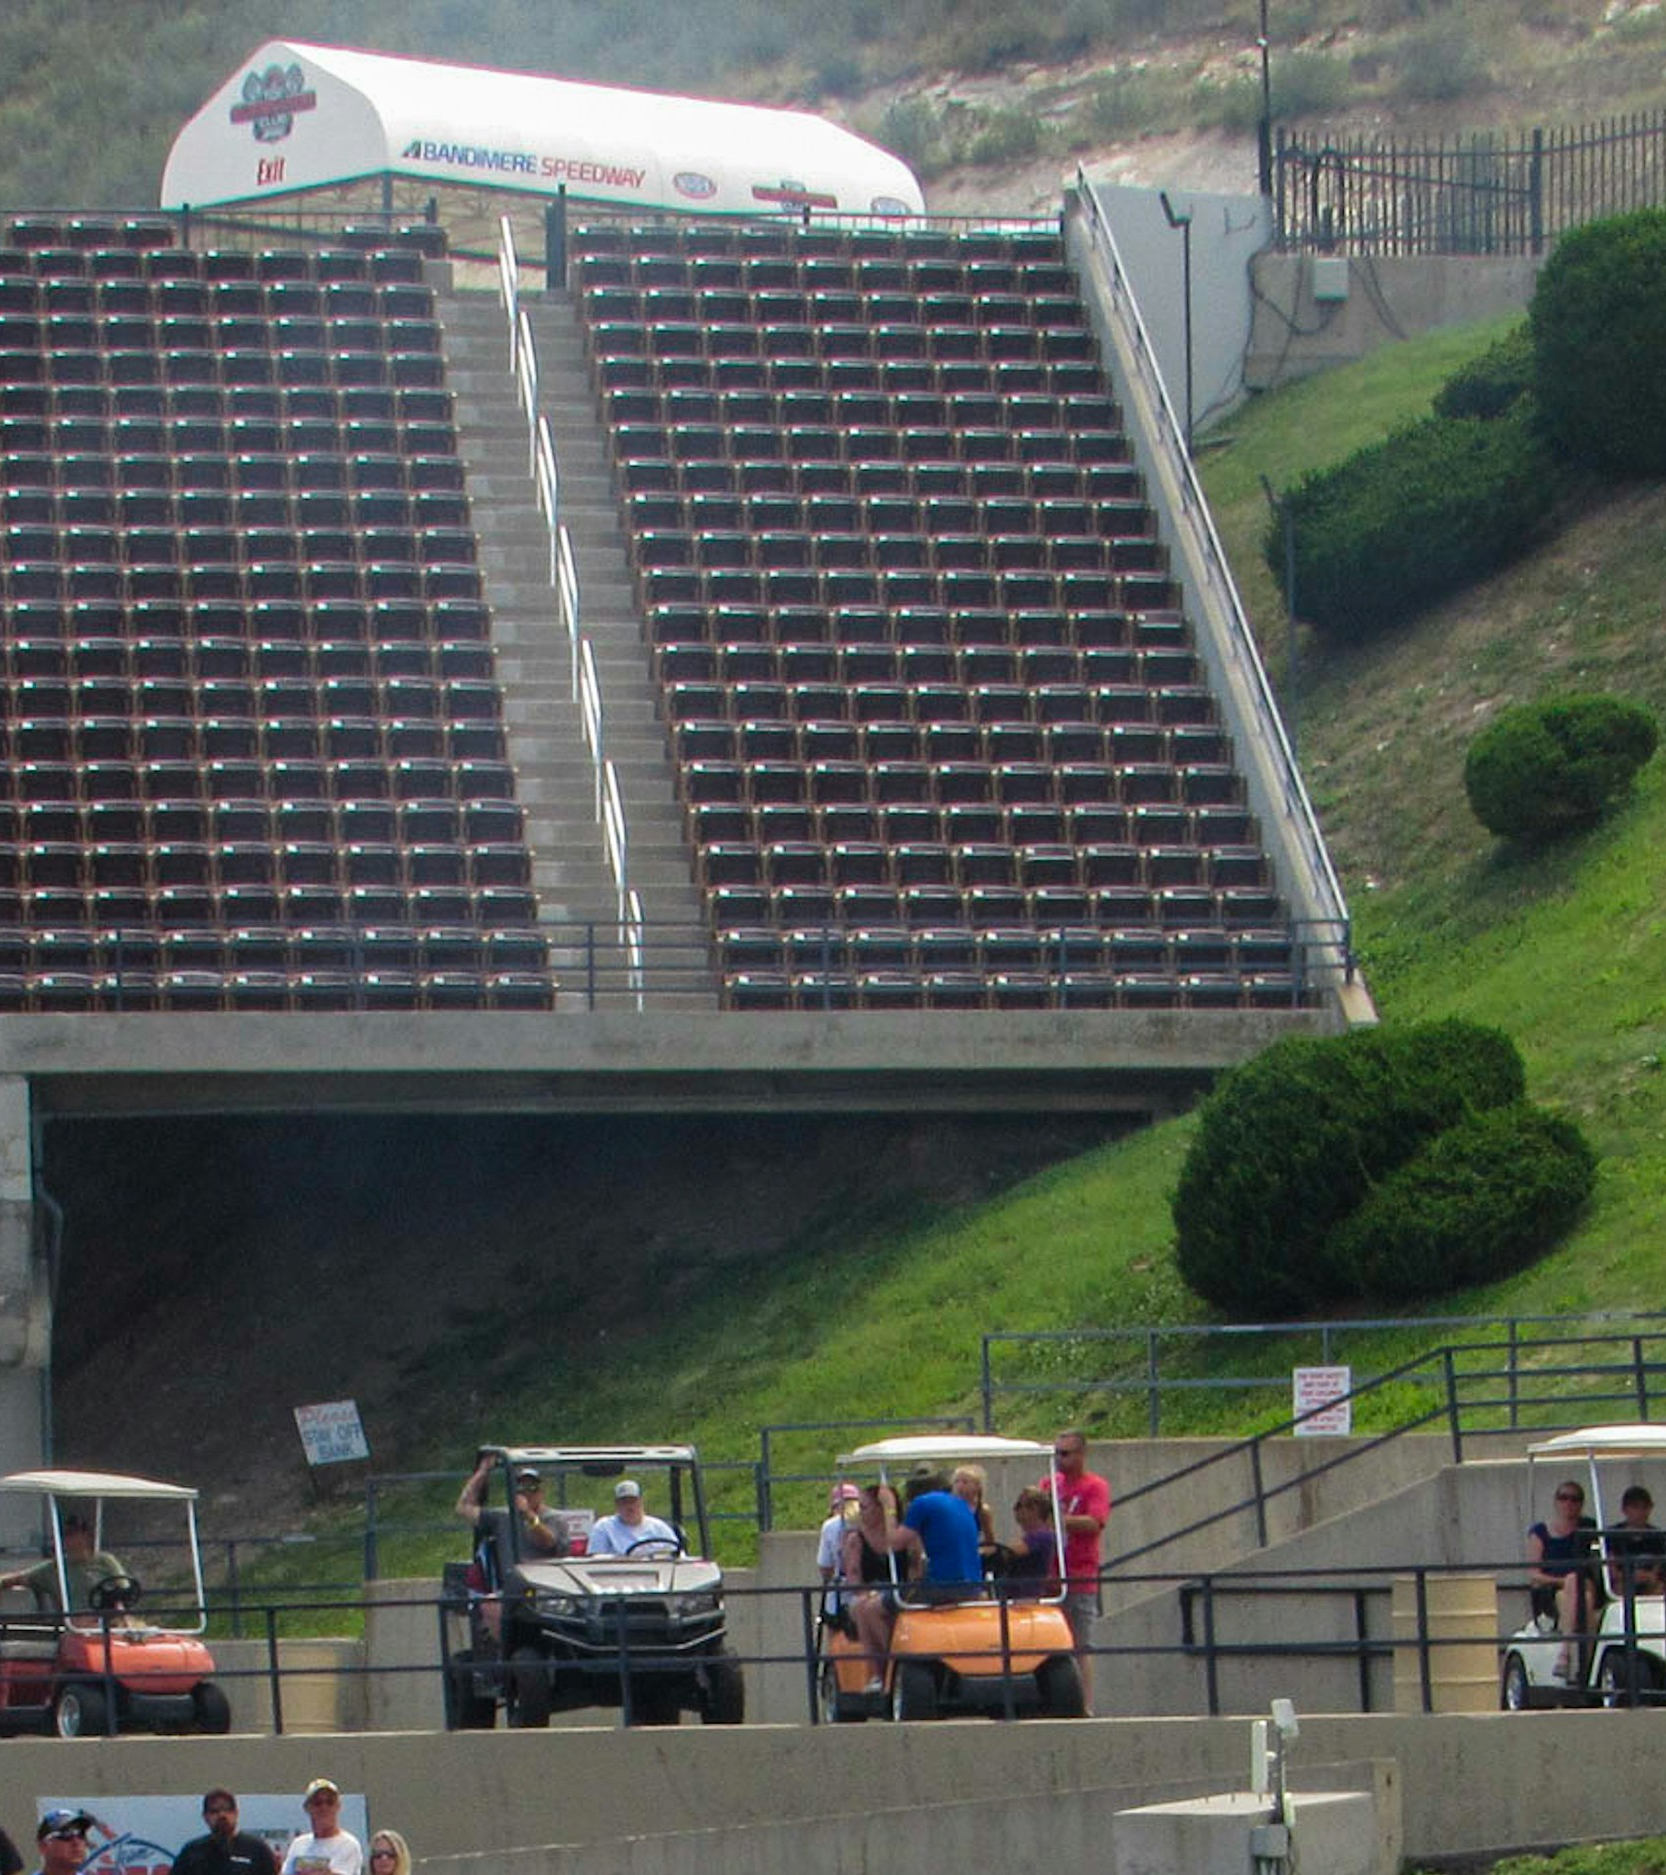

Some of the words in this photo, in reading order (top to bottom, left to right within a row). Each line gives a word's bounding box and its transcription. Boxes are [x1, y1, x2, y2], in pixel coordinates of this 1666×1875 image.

[256, 156, 286, 187] Exit
[423, 141, 537, 175] BANDIMERE
[540, 156, 646, 189] SPEEDWAY
